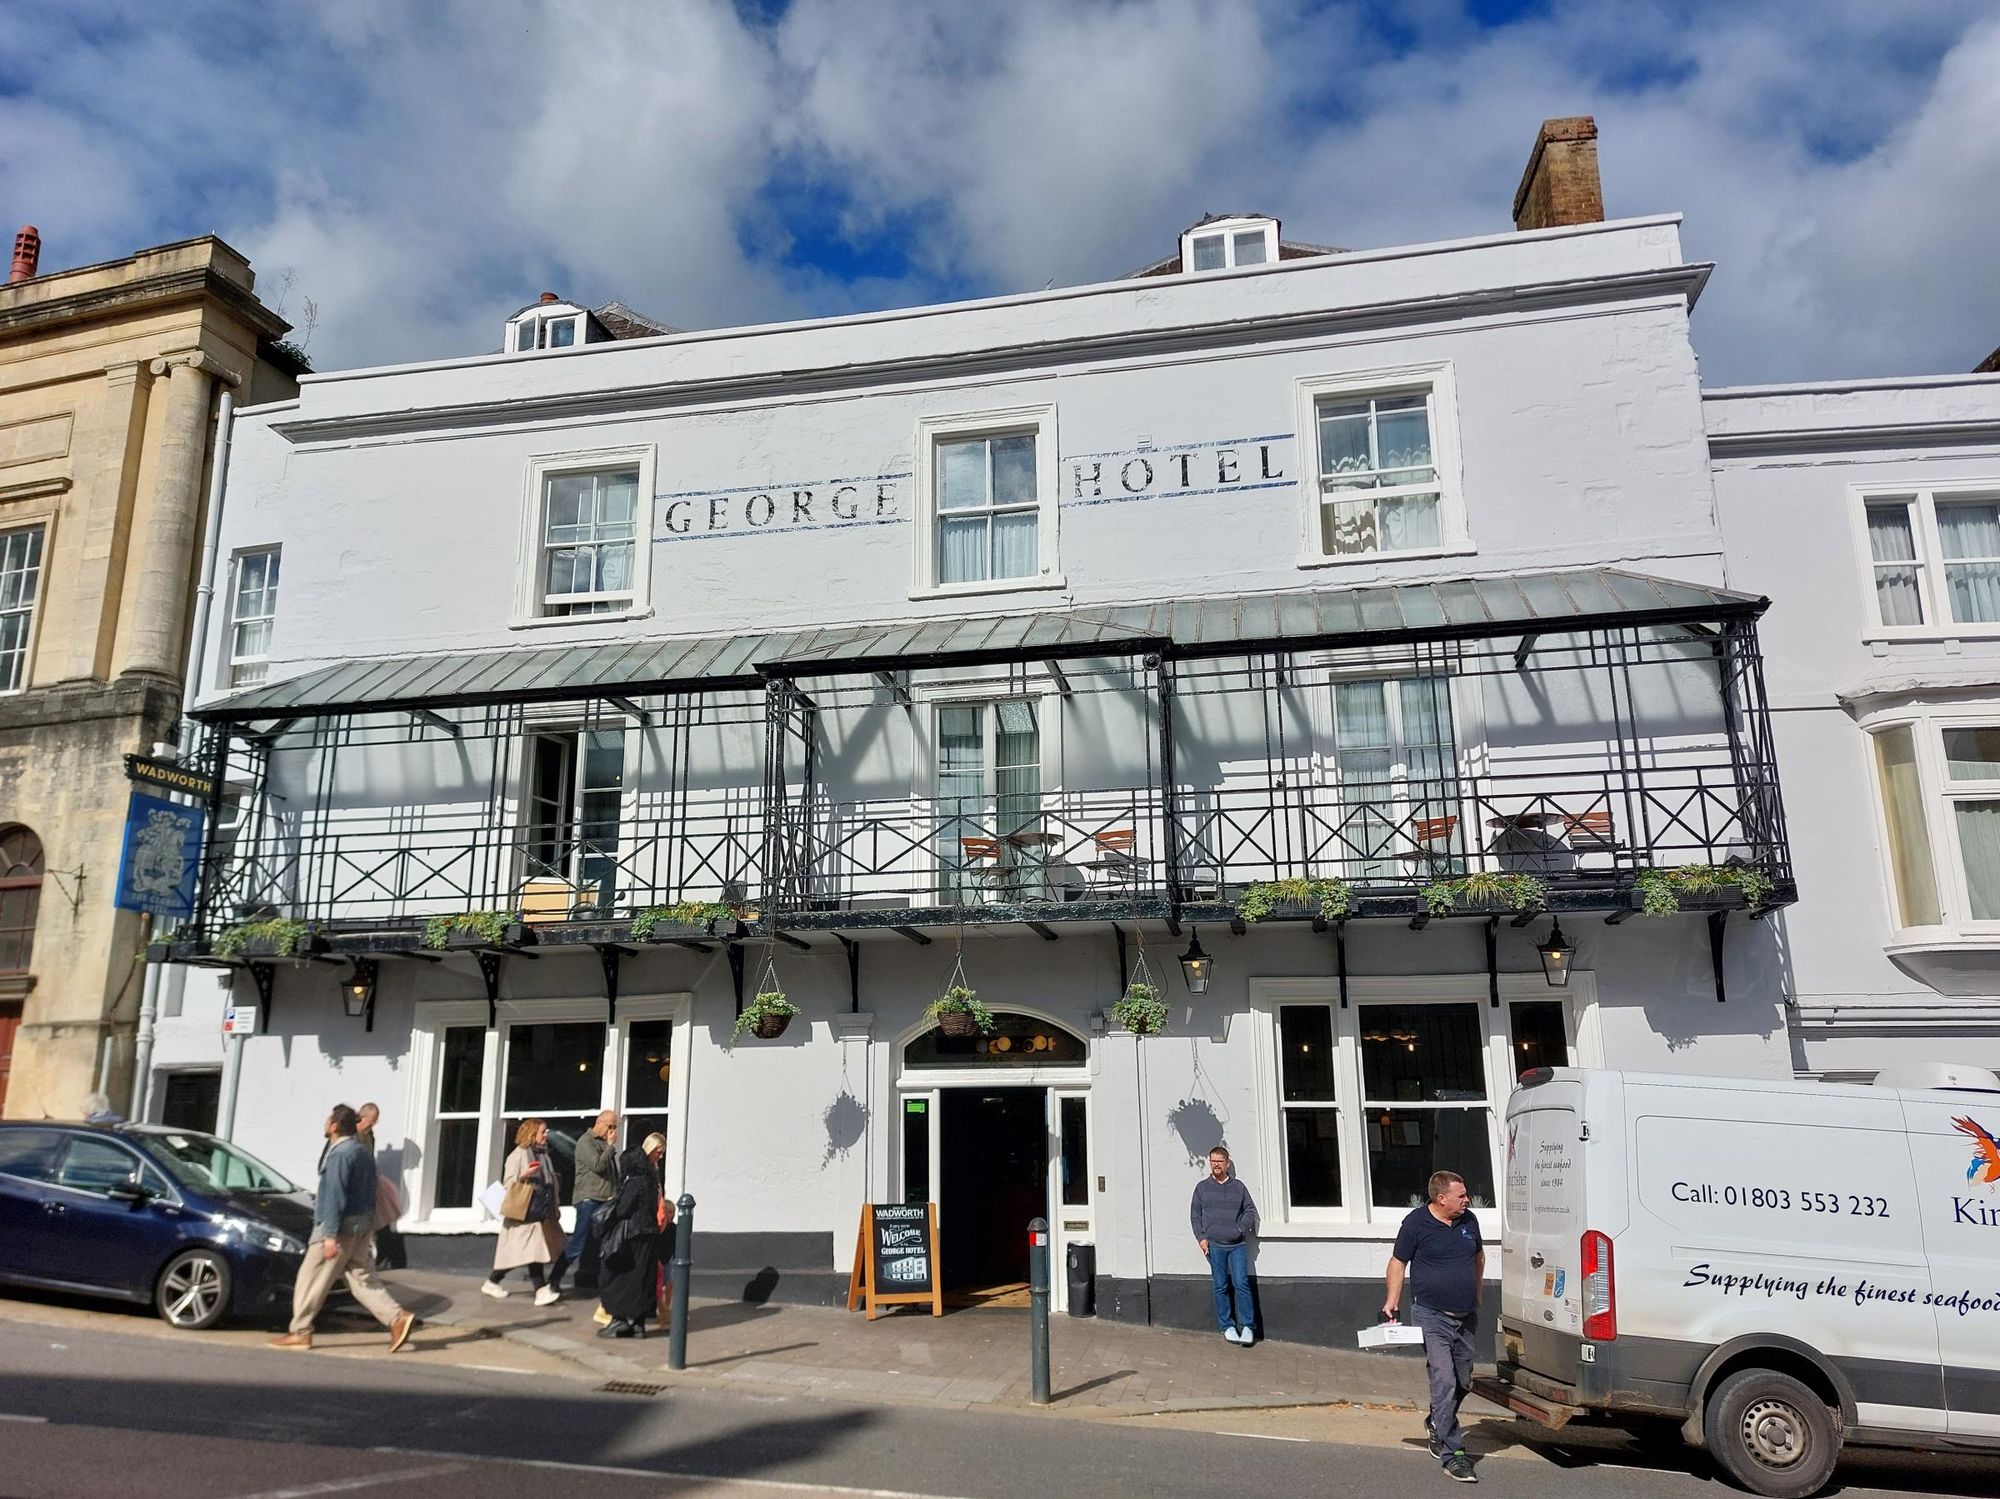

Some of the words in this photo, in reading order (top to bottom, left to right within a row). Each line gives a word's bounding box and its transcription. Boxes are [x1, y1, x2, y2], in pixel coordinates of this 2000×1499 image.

[665, 482, 899, 534] GEORGE
[1073, 445, 1285, 499] HOTEL
[136, 762, 212, 793] WADWORTH
[875, 1209, 924, 1217] WADWORTH
[1671, 1181, 1719, 1204] Call:
[1724, 1185, 1791, 1210] 01803
[1800, 1191, 1840, 1214] 553
[1848, 1195, 1890, 1218] 232
[880, 1247, 905, 1255] GEORGE
[905, 1246, 926, 1254] HOTEL
[1683, 1263, 1809, 1300] Supplying
[1815, 1276, 1848, 1297] the
[1854, 1279, 1917, 1306] finest
